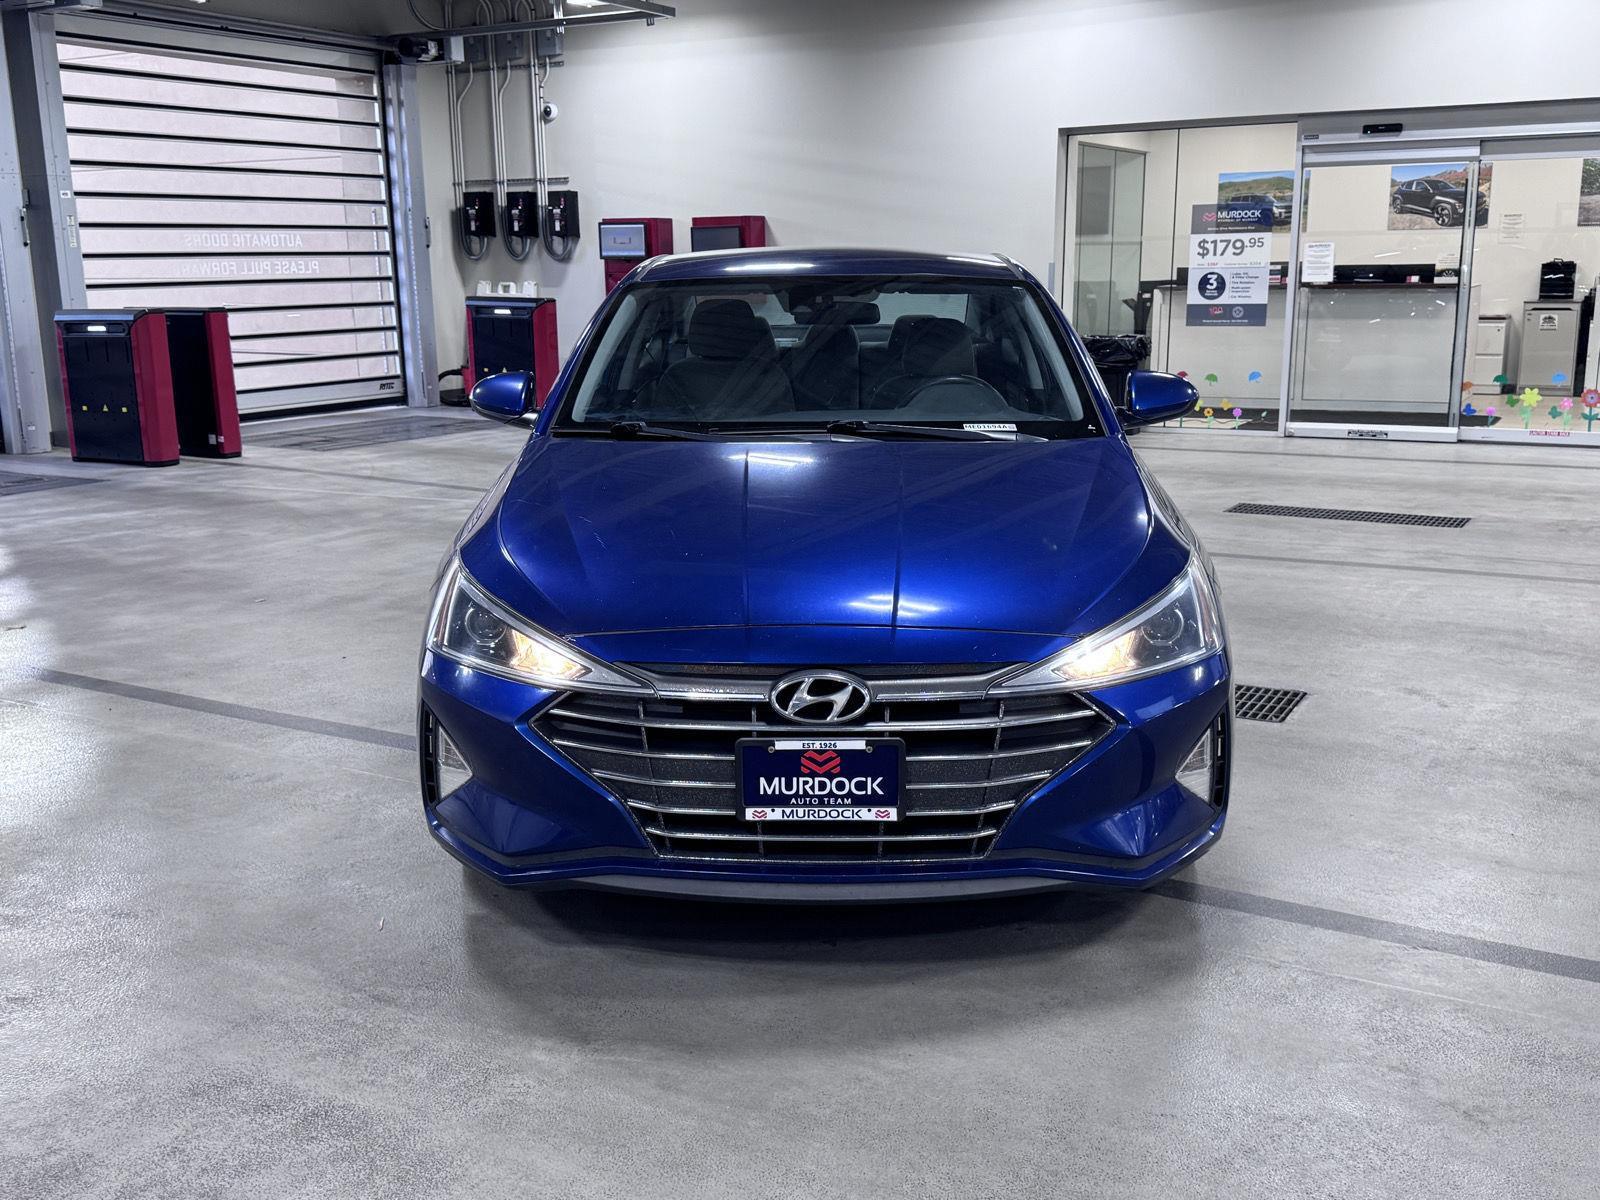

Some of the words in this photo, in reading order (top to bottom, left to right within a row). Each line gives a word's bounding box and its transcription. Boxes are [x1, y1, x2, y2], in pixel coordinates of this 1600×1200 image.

[1217, 210, 1262, 219] MURDOCK
[1206, 274, 1218, 290] 3
[759, 776, 884, 795] MURDOCK
[781, 808, 863, 819] MURDOCK
